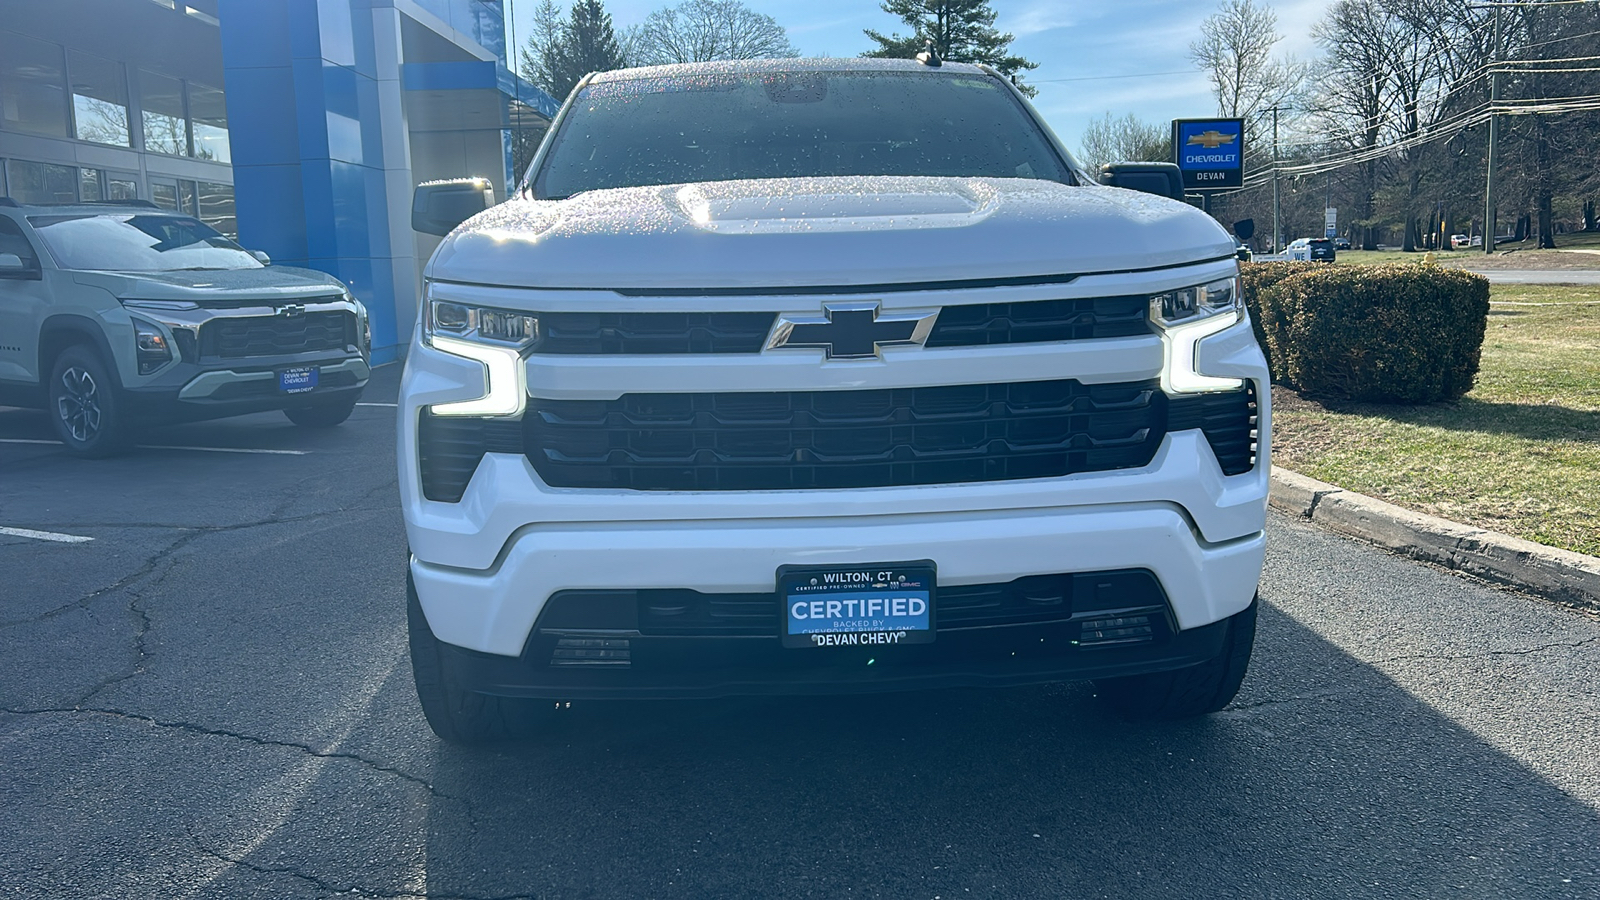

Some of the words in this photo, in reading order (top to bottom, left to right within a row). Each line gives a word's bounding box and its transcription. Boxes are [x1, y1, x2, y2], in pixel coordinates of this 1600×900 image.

[1186, 154, 1236, 163] CHEVROLET
[1197, 172, 1225, 180] DEVAN
[823, 572, 873, 583] WILTON,
[877, 571, 893, 581] CT
[791, 598, 926, 620] CERTIFIED
[833, 620, 869, 628] BACKED
[872, 619, 884, 627] BY
[817, 633, 858, 646] DEVAN
[860, 631, 900, 645] CHEVY
